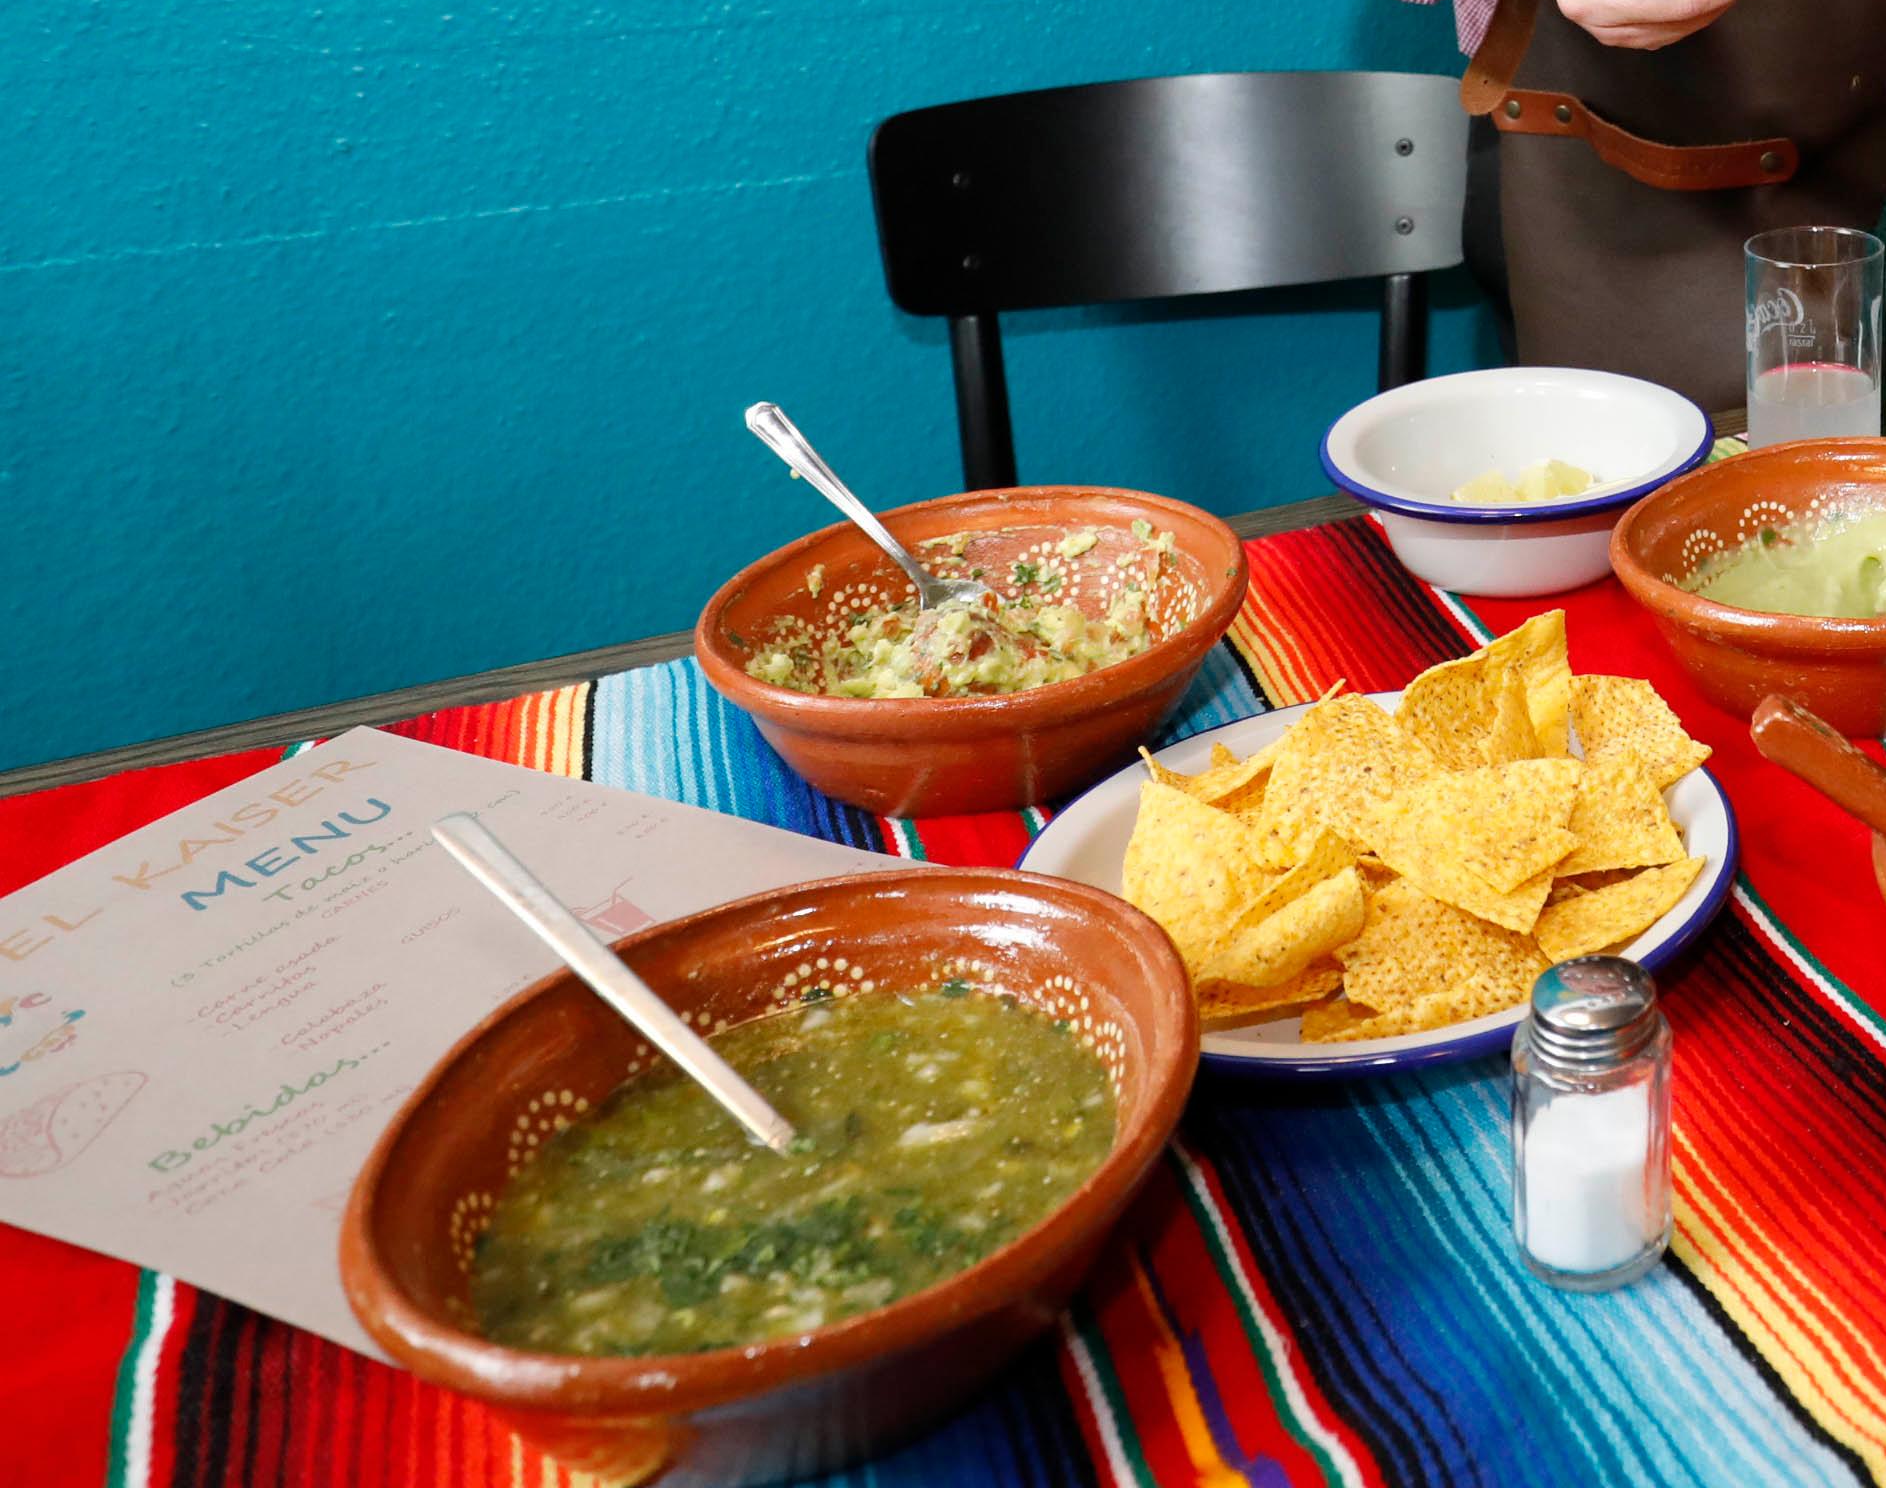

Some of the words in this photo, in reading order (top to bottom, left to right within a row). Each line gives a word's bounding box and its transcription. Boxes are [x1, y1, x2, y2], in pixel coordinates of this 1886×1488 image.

[0, 908, 104, 961] EL
[111, 759, 378, 890] KAISER
[180, 797, 392, 911] MENU
